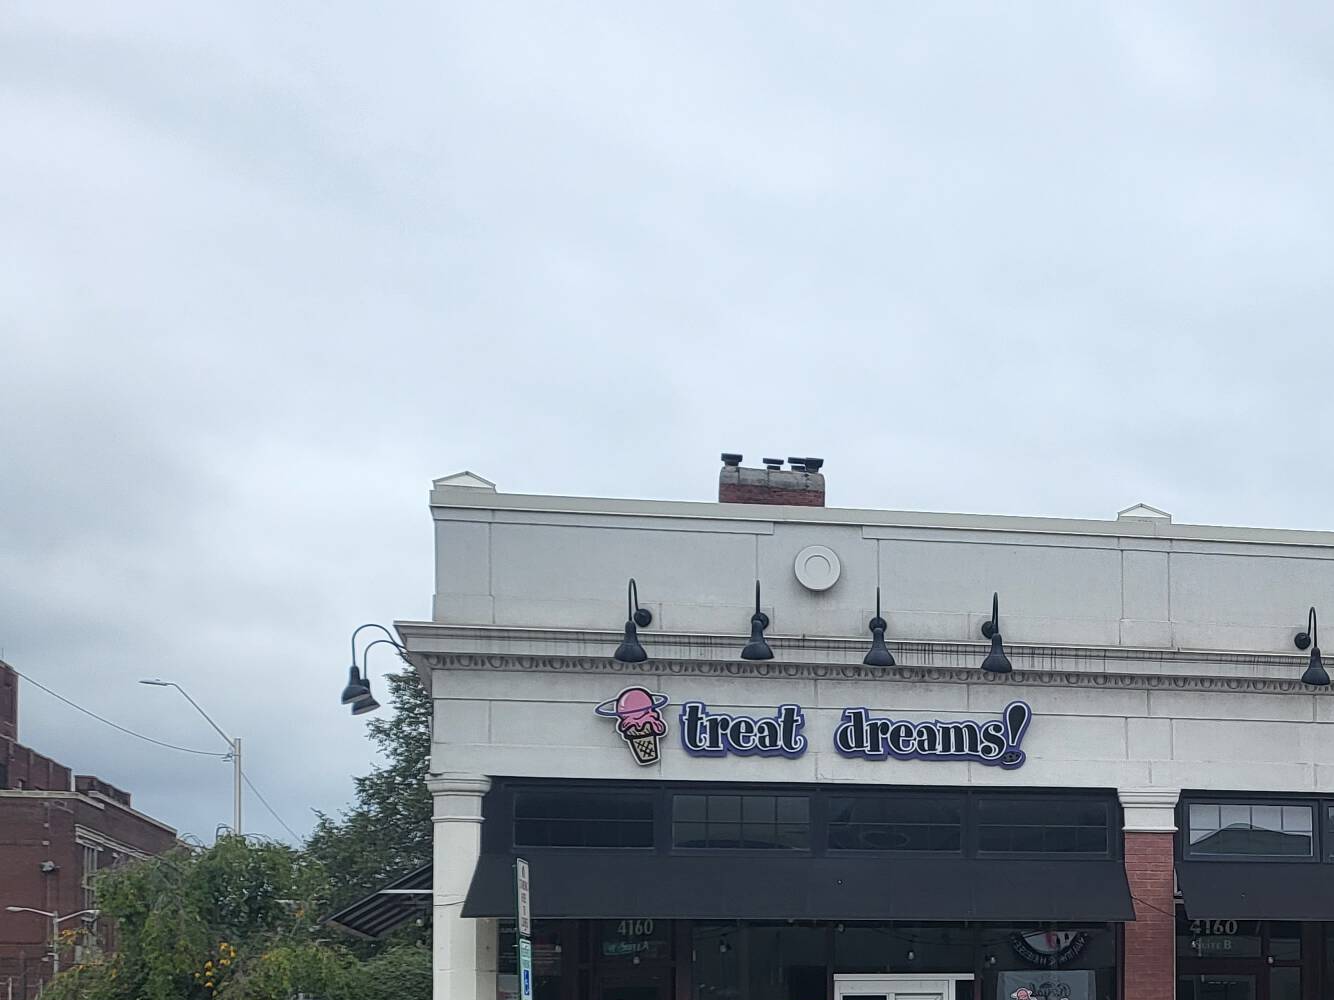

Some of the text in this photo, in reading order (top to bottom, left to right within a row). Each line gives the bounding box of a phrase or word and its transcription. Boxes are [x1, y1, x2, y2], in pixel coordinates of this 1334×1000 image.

[682, 702, 1030, 768] treat dreams!
[617, 919, 654, 935] 4160
[1190, 919, 1238, 935] 4160
